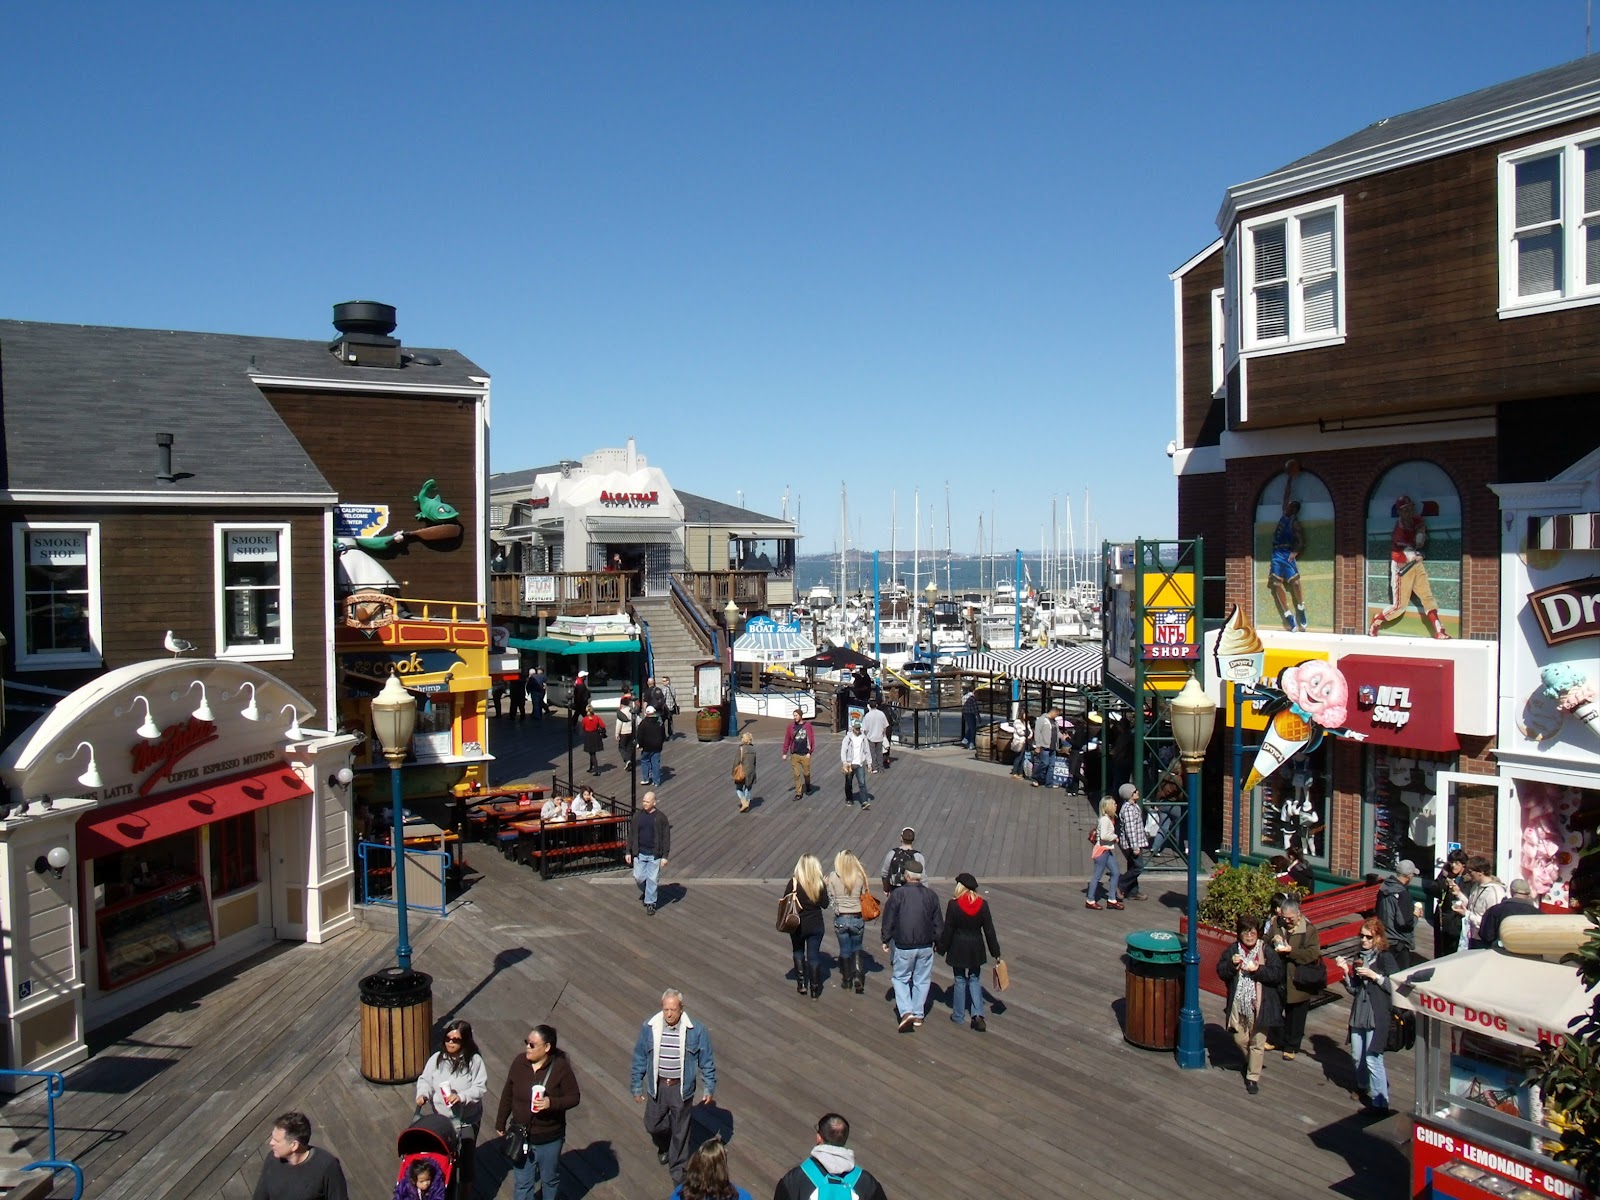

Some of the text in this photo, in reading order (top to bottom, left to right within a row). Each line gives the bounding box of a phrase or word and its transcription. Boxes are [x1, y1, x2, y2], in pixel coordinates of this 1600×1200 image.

[600, 490, 659, 505] ALCATRAZ
[34, 538, 81, 547] SMOKE
[231, 536, 272, 544] SMOKE
[40, 550, 76, 558] SHOP
[237, 547, 268, 555] SHOP
[527, 582, 552, 590] FUN
[748, 624, 797, 633] BOAT Rides
[1157, 625, 1185, 643] NFL
[1152, 647, 1190, 657] SHOP
[373, 652, 424, 675] cook
[412, 685, 441, 693] hrimp
[1376, 685, 1412, 708] NFL
[1372, 705, 1410, 728] Shop
[1262, 742, 1284, 763] Dreyer's
[103, 784, 134, 799] LATTE
[167, 768, 199, 784] COFFEE
[202, 758, 240, 775] ESPRESSO
[242, 750, 275, 766] MUFFINS
[1420, 993, 1456, 1016] HOT
[1464, 1007, 1508, 1032] DOG
[1416, 1126, 1454, 1153] CHIPS
[1463, 1144, 1533, 1184] LEMONADE
